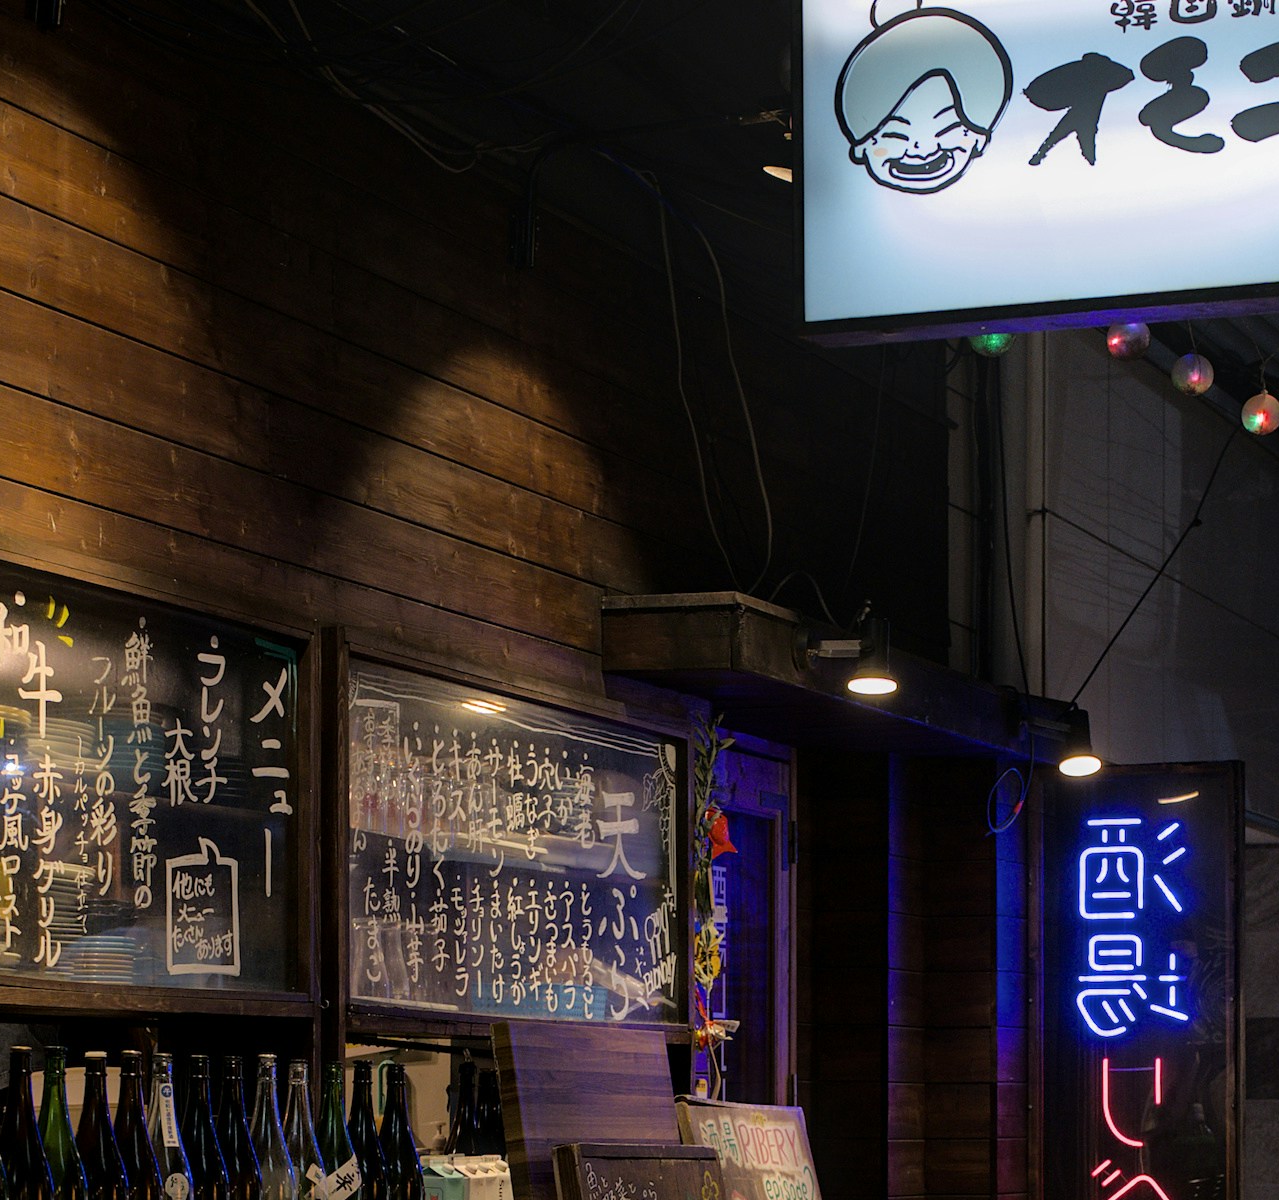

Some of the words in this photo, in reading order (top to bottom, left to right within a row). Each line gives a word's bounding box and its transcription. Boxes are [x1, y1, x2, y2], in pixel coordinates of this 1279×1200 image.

[32, 756, 64, 968] 赤身グリル
[161, 718, 198, 808] 大根
[250, 666, 293, 898] メニュー
[596, 791, 648, 1021] 天ぷら
[738, 1124, 800, 1167] RIBERY
